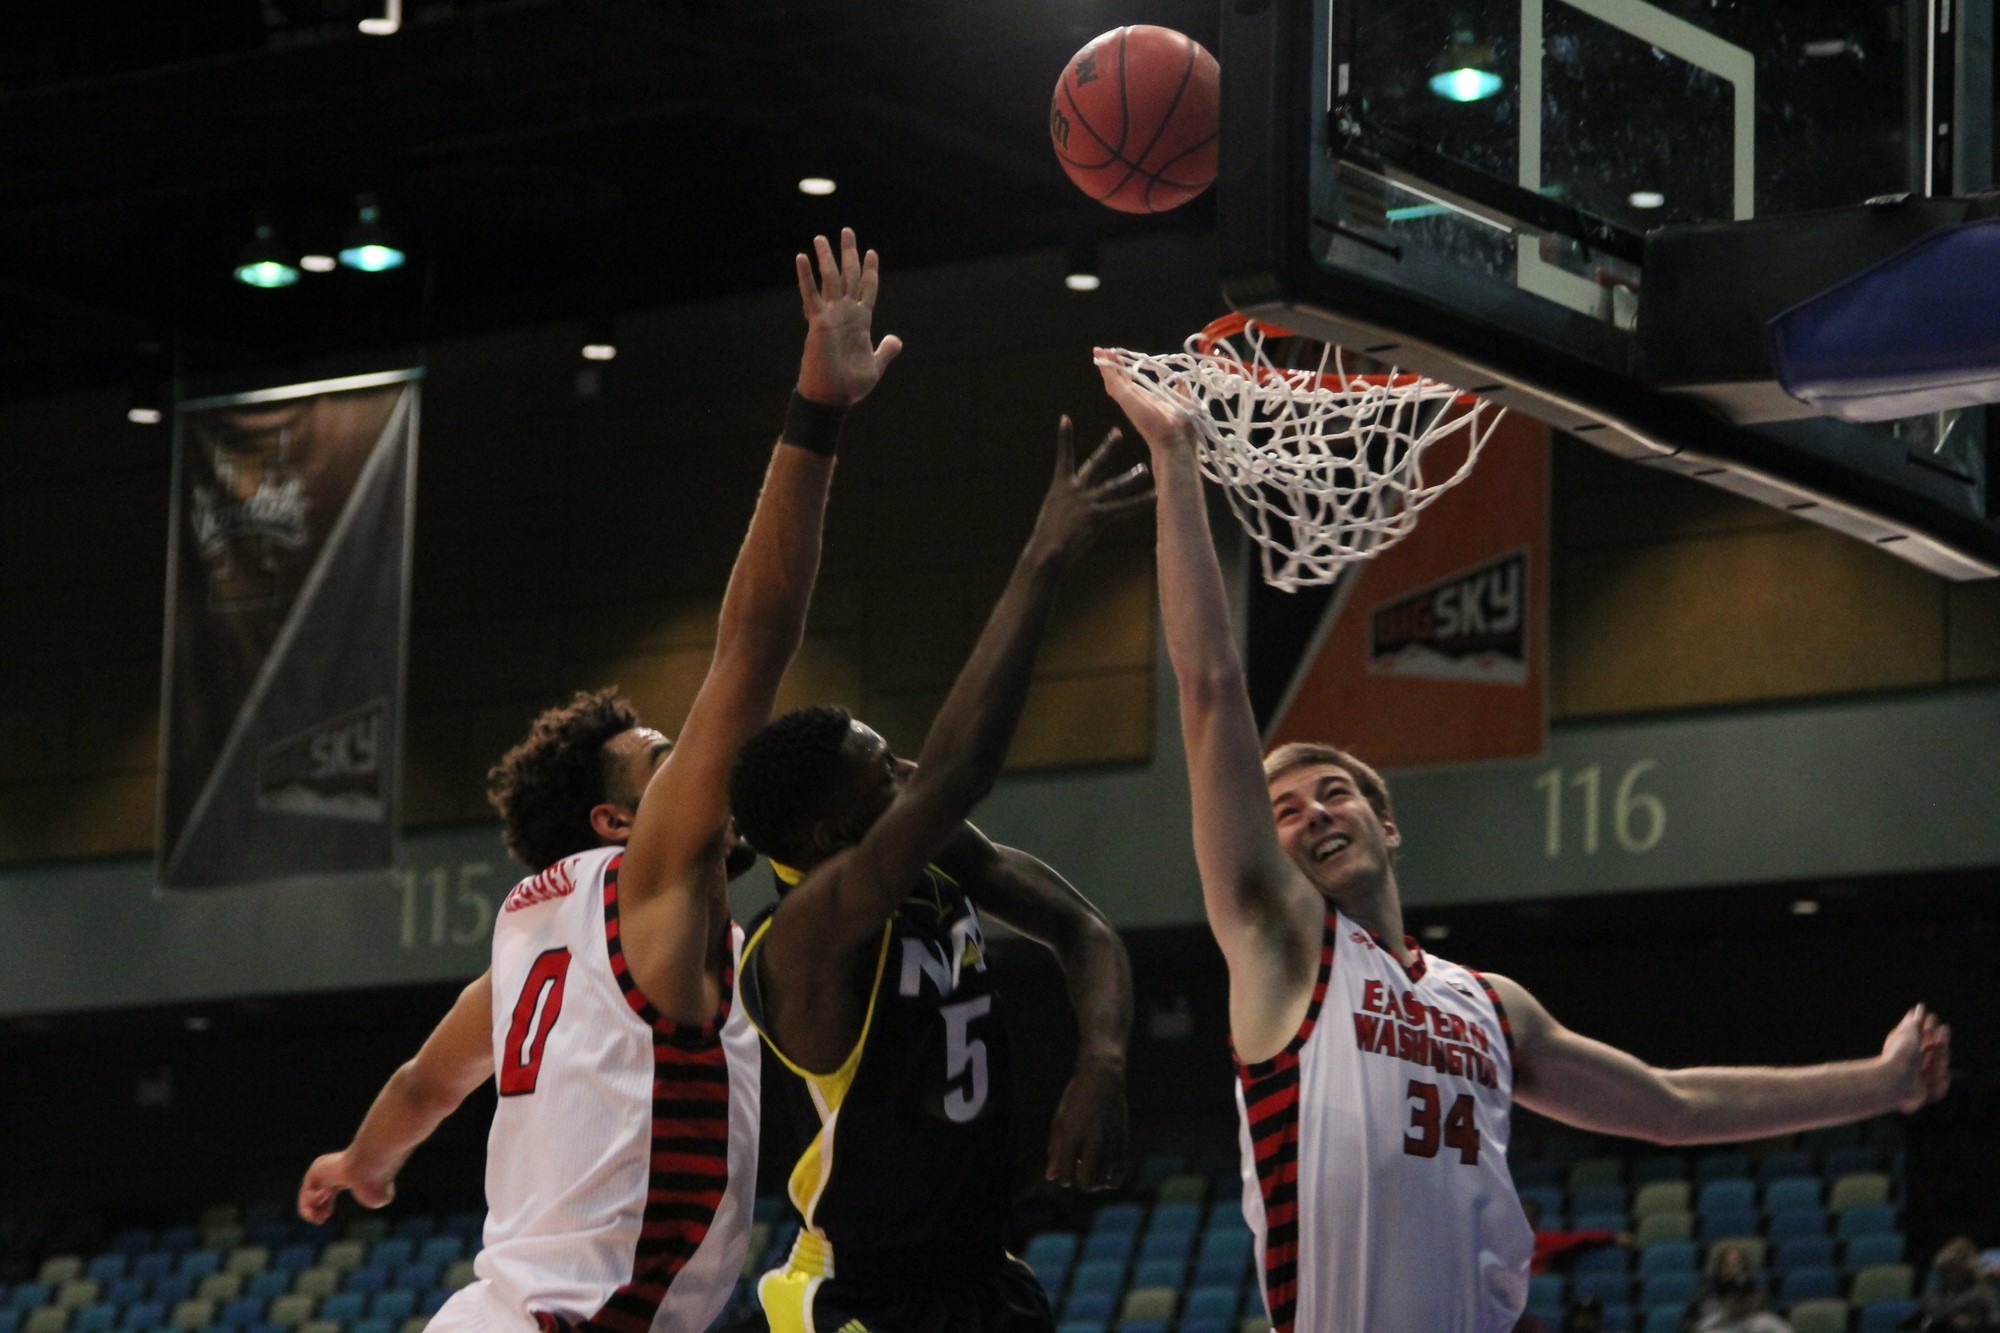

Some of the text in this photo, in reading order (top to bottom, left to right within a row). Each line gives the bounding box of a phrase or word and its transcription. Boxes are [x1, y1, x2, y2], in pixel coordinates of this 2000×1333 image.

[1533, 759, 1666, 857] 116
[391, 863, 492, 947] 115
[500, 946, 572, 1097] 0
[1353, 1012, 1498, 1090] WASHNGTO
[1363, 978, 1489, 1050] EASERN
[938, 994, 992, 1123] 5
[1403, 1079, 1481, 1166] 34
